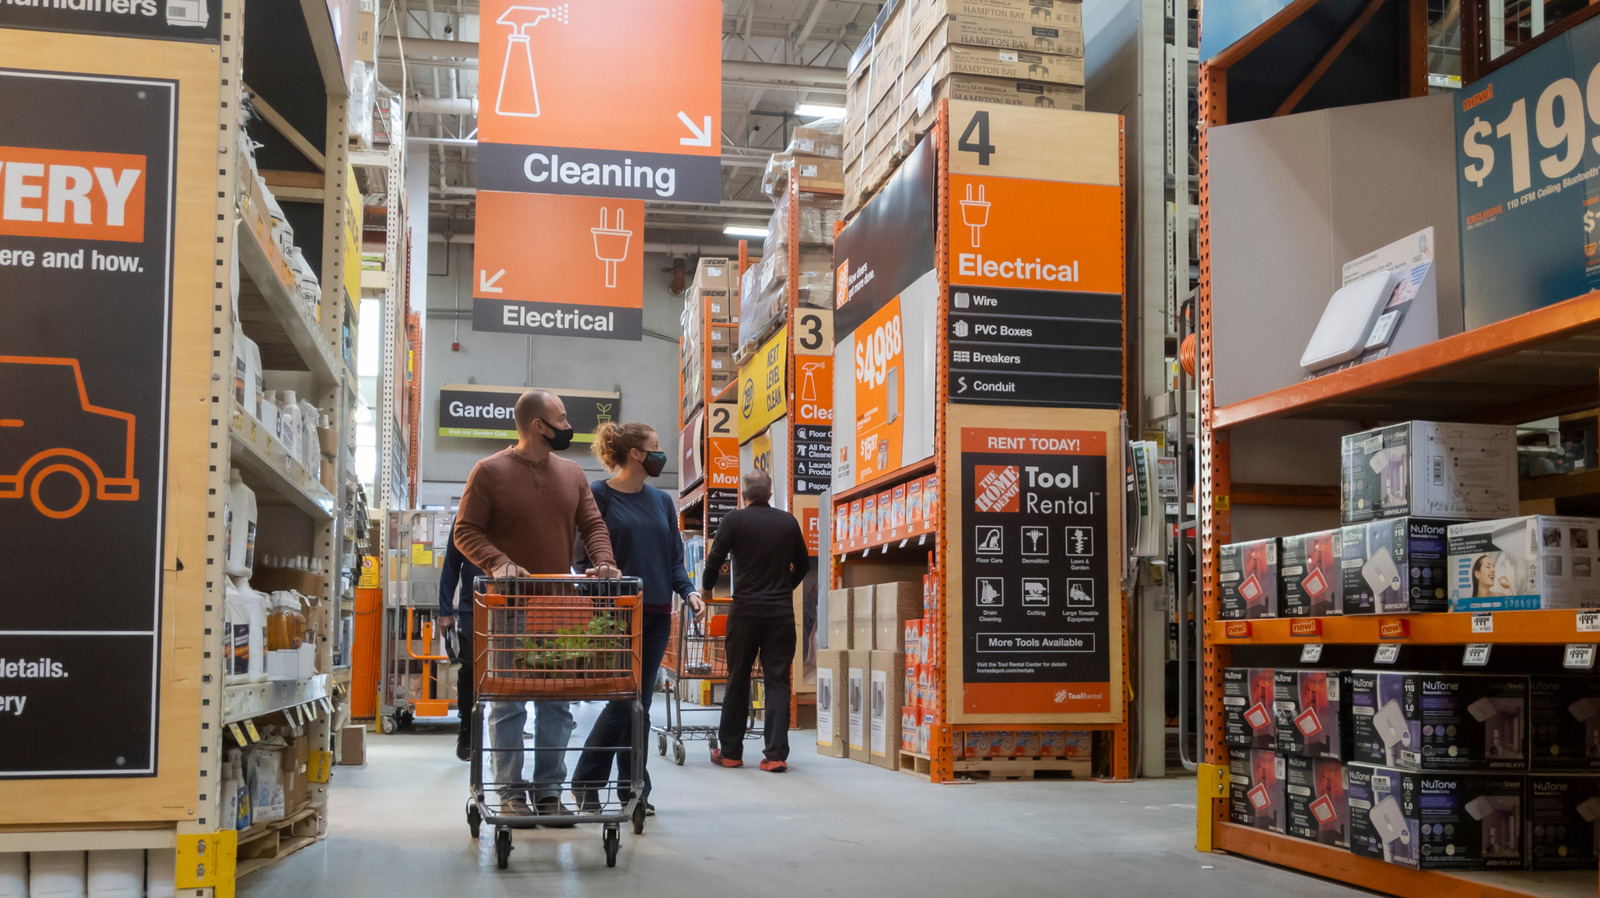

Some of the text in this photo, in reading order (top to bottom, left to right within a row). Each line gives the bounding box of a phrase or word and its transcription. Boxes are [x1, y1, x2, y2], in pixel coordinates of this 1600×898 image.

[963, 5, 1026, 20] HAMPTON BAY
[961, 34, 1029, 49] HAMPTON BAY
[955, 64, 1018, 76] HAMPTON BAY
[1463, 83, 1494, 112] new!
[1463, 61, 1600, 194] $19
[958, 110, 996, 166] 4
[523, 153, 676, 197] Cleaning
[0, 161, 142, 227] ERY
[1520, 192, 1536, 206] CFM
[1537, 182, 1562, 199] Ceiling
[1466, 204, 1503, 225] EXCLUSIVE
[42, 249, 84, 270] and
[91, 251, 144, 272] how.
[958, 252, 1079, 283] Electrical
[973, 295, 998, 307] Wire
[503, 305, 614, 332] Electrical
[799, 313, 824, 350] 3
[974, 324, 1033, 337] PVC Boxes
[767, 343, 780, 369] NEXT
[973, 352, 1021, 364] Breakers
[766, 364, 780, 391] LEVEL
[973, 380, 1016, 393] Conduit
[766, 385, 782, 412] CLEAN
[448, 400, 516, 420] Garden
[712, 407, 731, 433] 2
[809, 430, 826, 438] Floor
[988, 436, 1081, 451] RENT TODAY!
[979, 470, 998, 490] THE
[1025, 465, 1079, 488] Tool
[974, 465, 1020, 513] HOME
[992, 483, 1020, 513] DEPOT
[1026, 491, 1094, 515] Rental
[1410, 524, 1446, 535] NuTone
[1228, 624, 1248, 635] new!
[1293, 620, 1316, 632] new!
[1381, 622, 1403, 635] new!
[988, 638, 1084, 647] More Tools Available
[1224, 672, 1242, 680] NuTone
[1274, 674, 1292, 682] NuTone
[1353, 679, 1374, 688] NuTone
[1405, 684, 1415, 692] 110
[1422, 681, 1459, 690] NuTone
[1067, 692, 1103, 700] ToolRental
[1405, 704, 1415, 712] 1.0
[1230, 750, 1246, 758] NuTone
[1289, 759, 1307, 768] NuTone
[1349, 771, 1371, 781] NuTone
[1403, 781, 1414, 790] 110
[1421, 780, 1457, 790] NuTone
[1533, 782, 1568, 791] NuTone
[1404, 802, 1413, 810] 1.0
